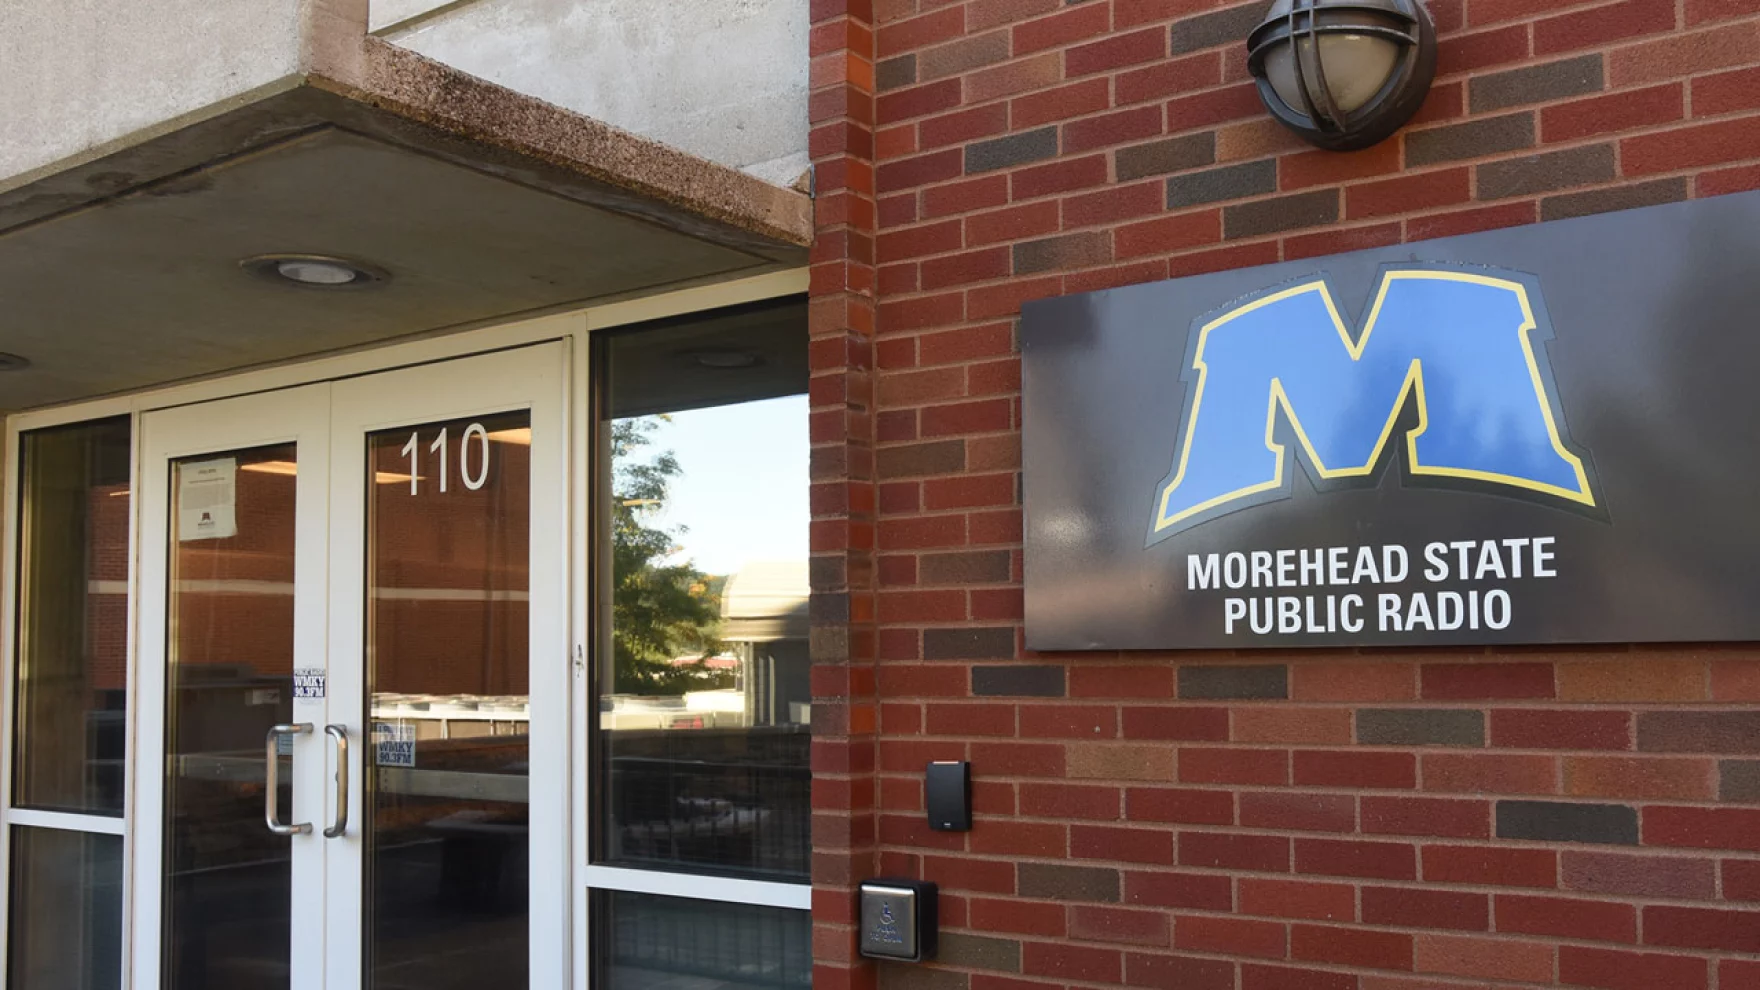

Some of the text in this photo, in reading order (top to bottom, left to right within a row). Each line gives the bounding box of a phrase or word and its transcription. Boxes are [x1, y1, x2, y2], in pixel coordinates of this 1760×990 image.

[401, 422, 490, 496] 110
[1187, 537, 1557, 590] MOREHEAD STATE
[1224, 589, 1512, 635] PUBLIC RADIO
[294, 675, 324, 687] WMKY
[295, 686, 324, 697] 90.3FM
[380, 741, 412, 752] WMKY
[380, 752, 411, 764] 90.3FM
